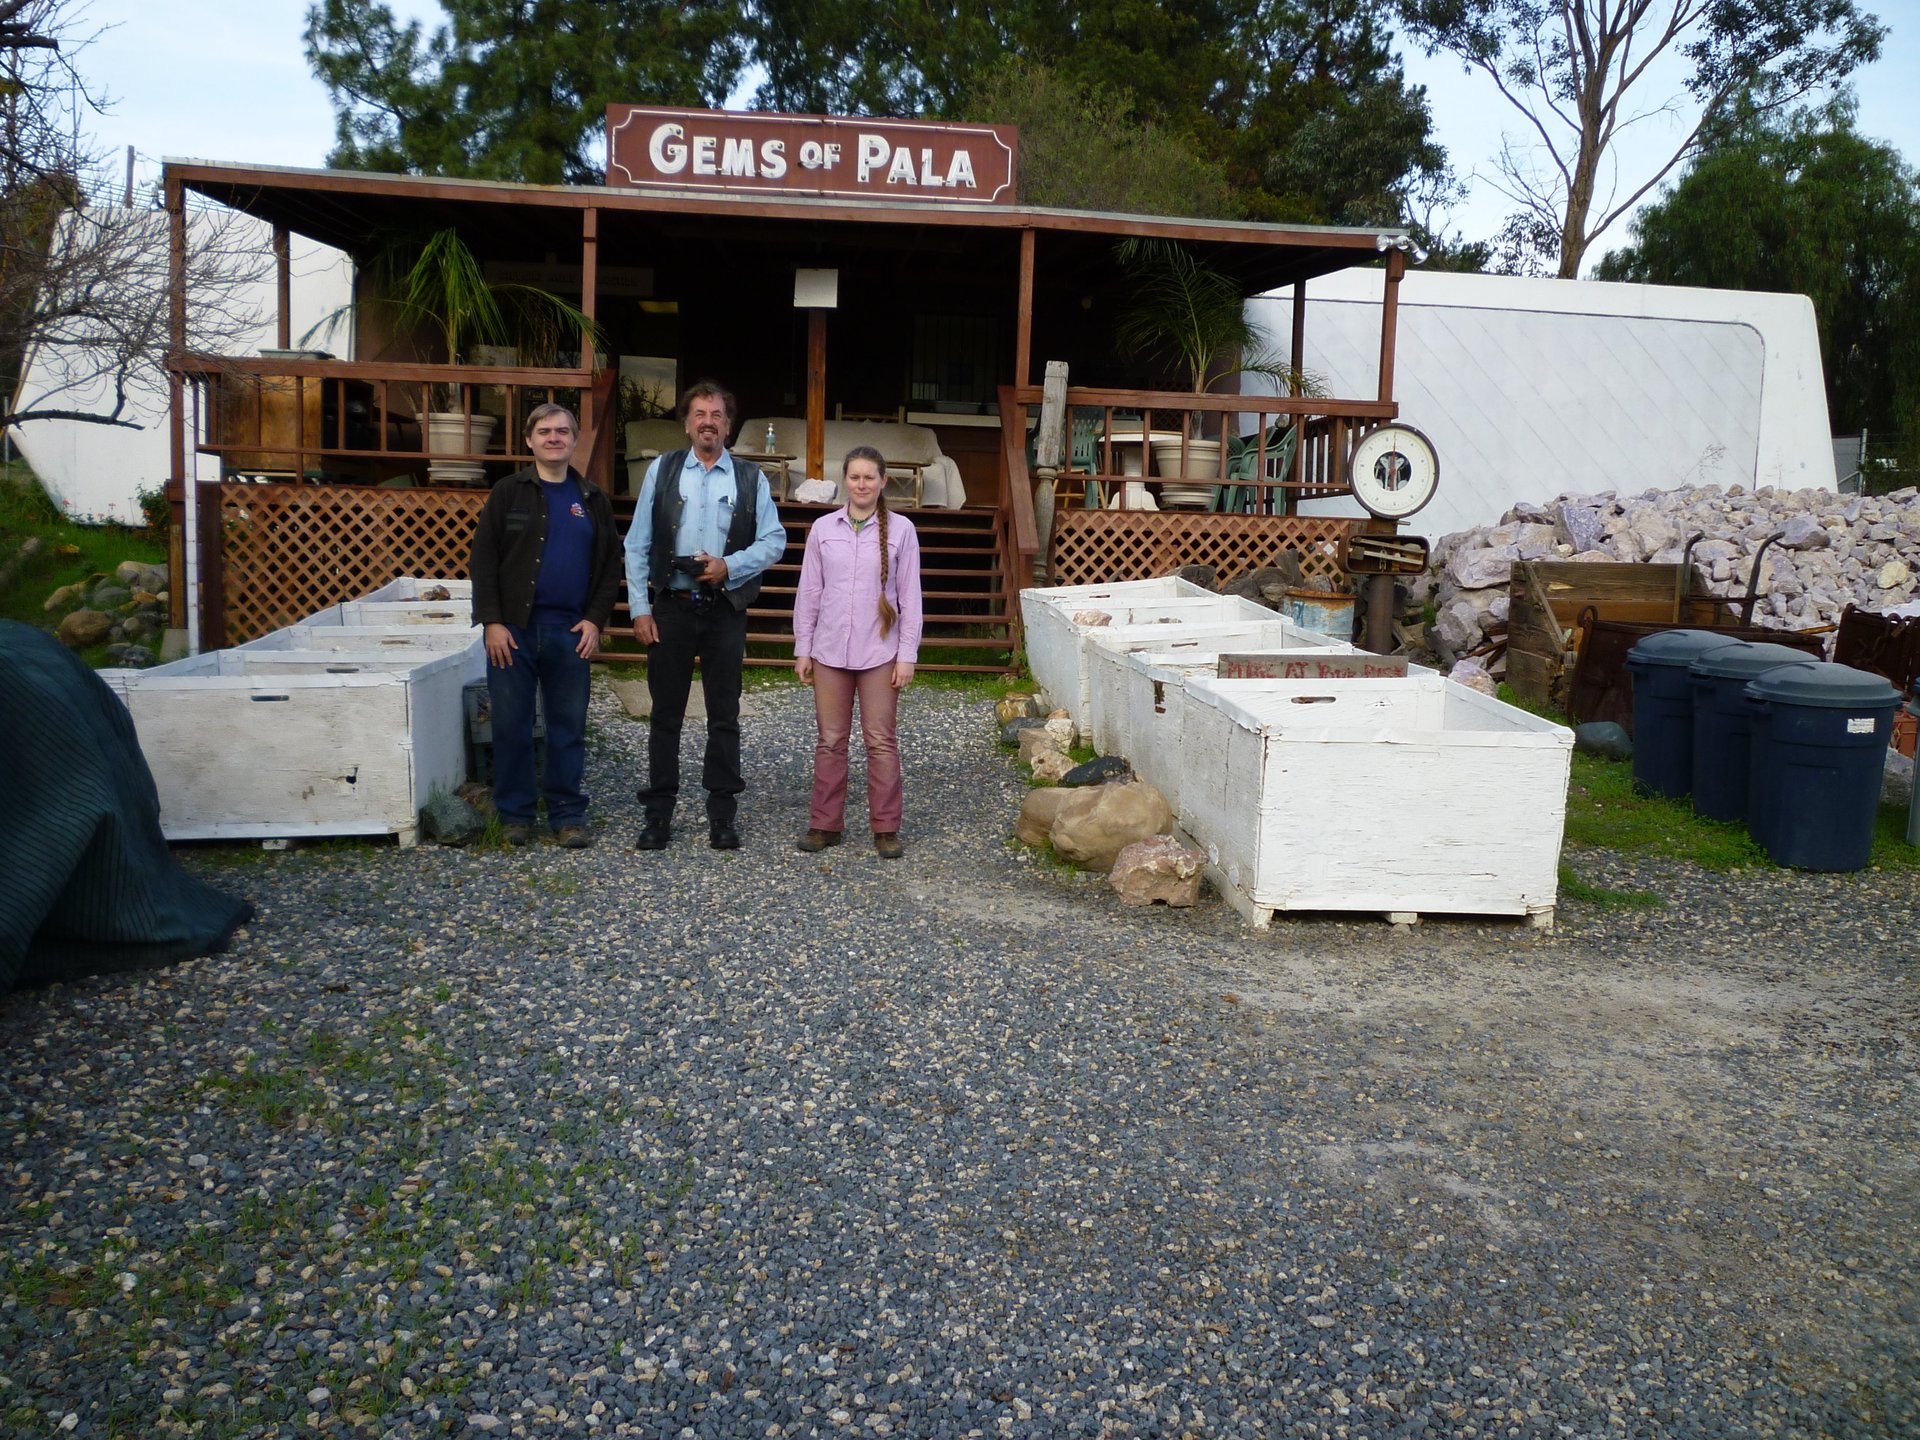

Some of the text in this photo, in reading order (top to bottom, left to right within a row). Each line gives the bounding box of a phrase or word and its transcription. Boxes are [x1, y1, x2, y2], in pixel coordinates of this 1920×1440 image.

[649, 122, 977, 188] GEMS OF PALA
